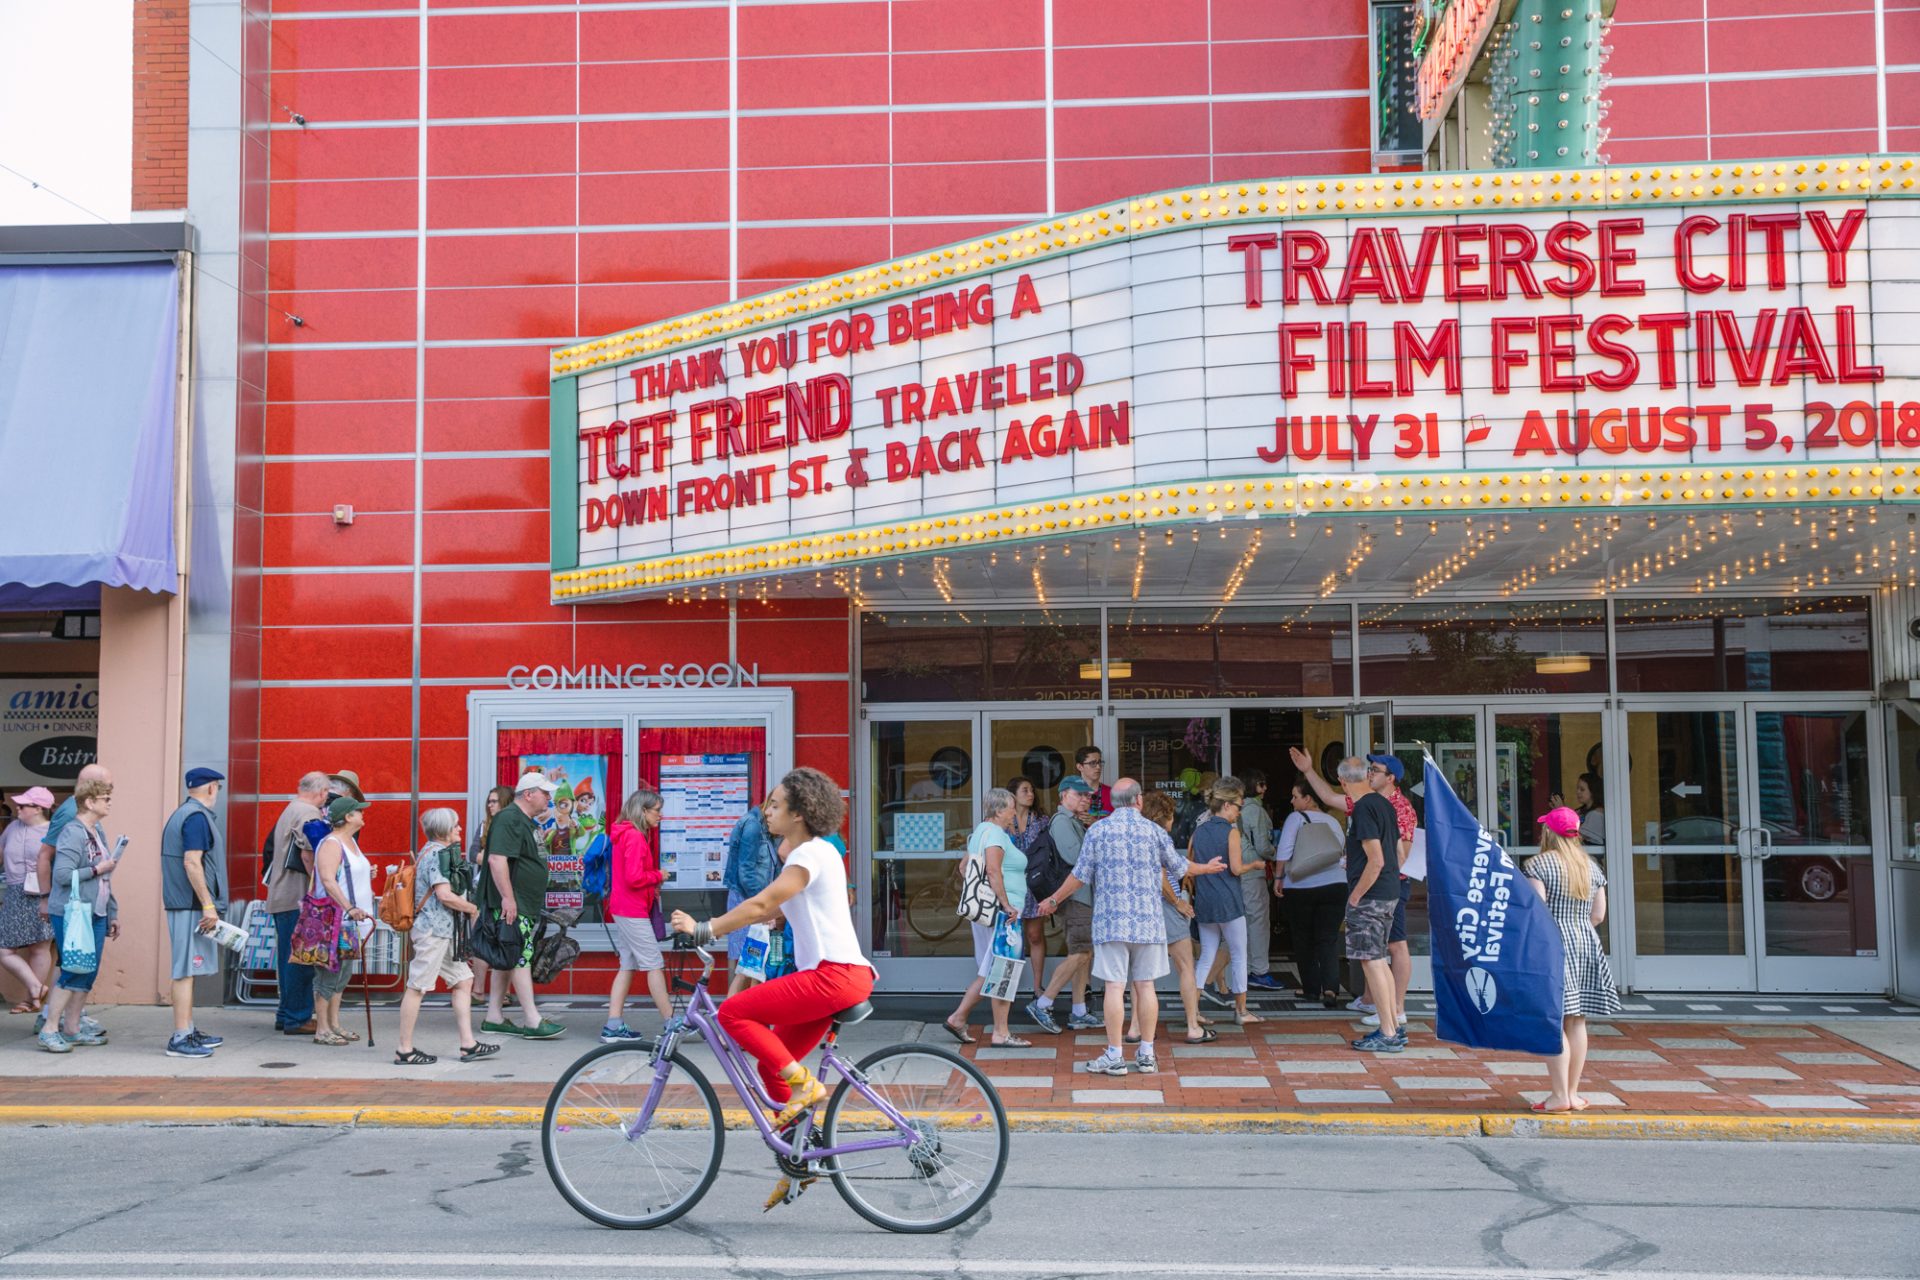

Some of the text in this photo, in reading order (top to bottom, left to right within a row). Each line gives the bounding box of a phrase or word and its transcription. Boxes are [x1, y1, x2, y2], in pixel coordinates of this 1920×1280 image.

[1228, 208, 1867, 309] TRAVERSE CITY
[630, 274, 1041, 404] THANK YOU FOR BEING A
[1278, 305, 1885, 399] FILM FESTIVAL
[579, 352, 1084, 485] TCFF FRIEND TRAVELED
[1257, 413, 1380, 463] JULY
[1393, 412, 1440, 459] 31
[1513, 404, 1731, 457] AUGUST
[1744, 403, 1793, 454] 5,
[1804, 400, 1920, 449] 2018
[586, 401, 1130, 533] DOWN FRONT ST. & BACK AGAIN
[506, 663, 758, 691] COMING SOON
[9, 683, 98, 709] amic
[3, 722, 92, 732] LUNCH DINNER
[41, 746, 98, 765] Bistr
[1155, 781, 1187, 789] ENTER
[1164, 791, 1184, 799] ERE
[547, 857, 585, 871] NOMES
